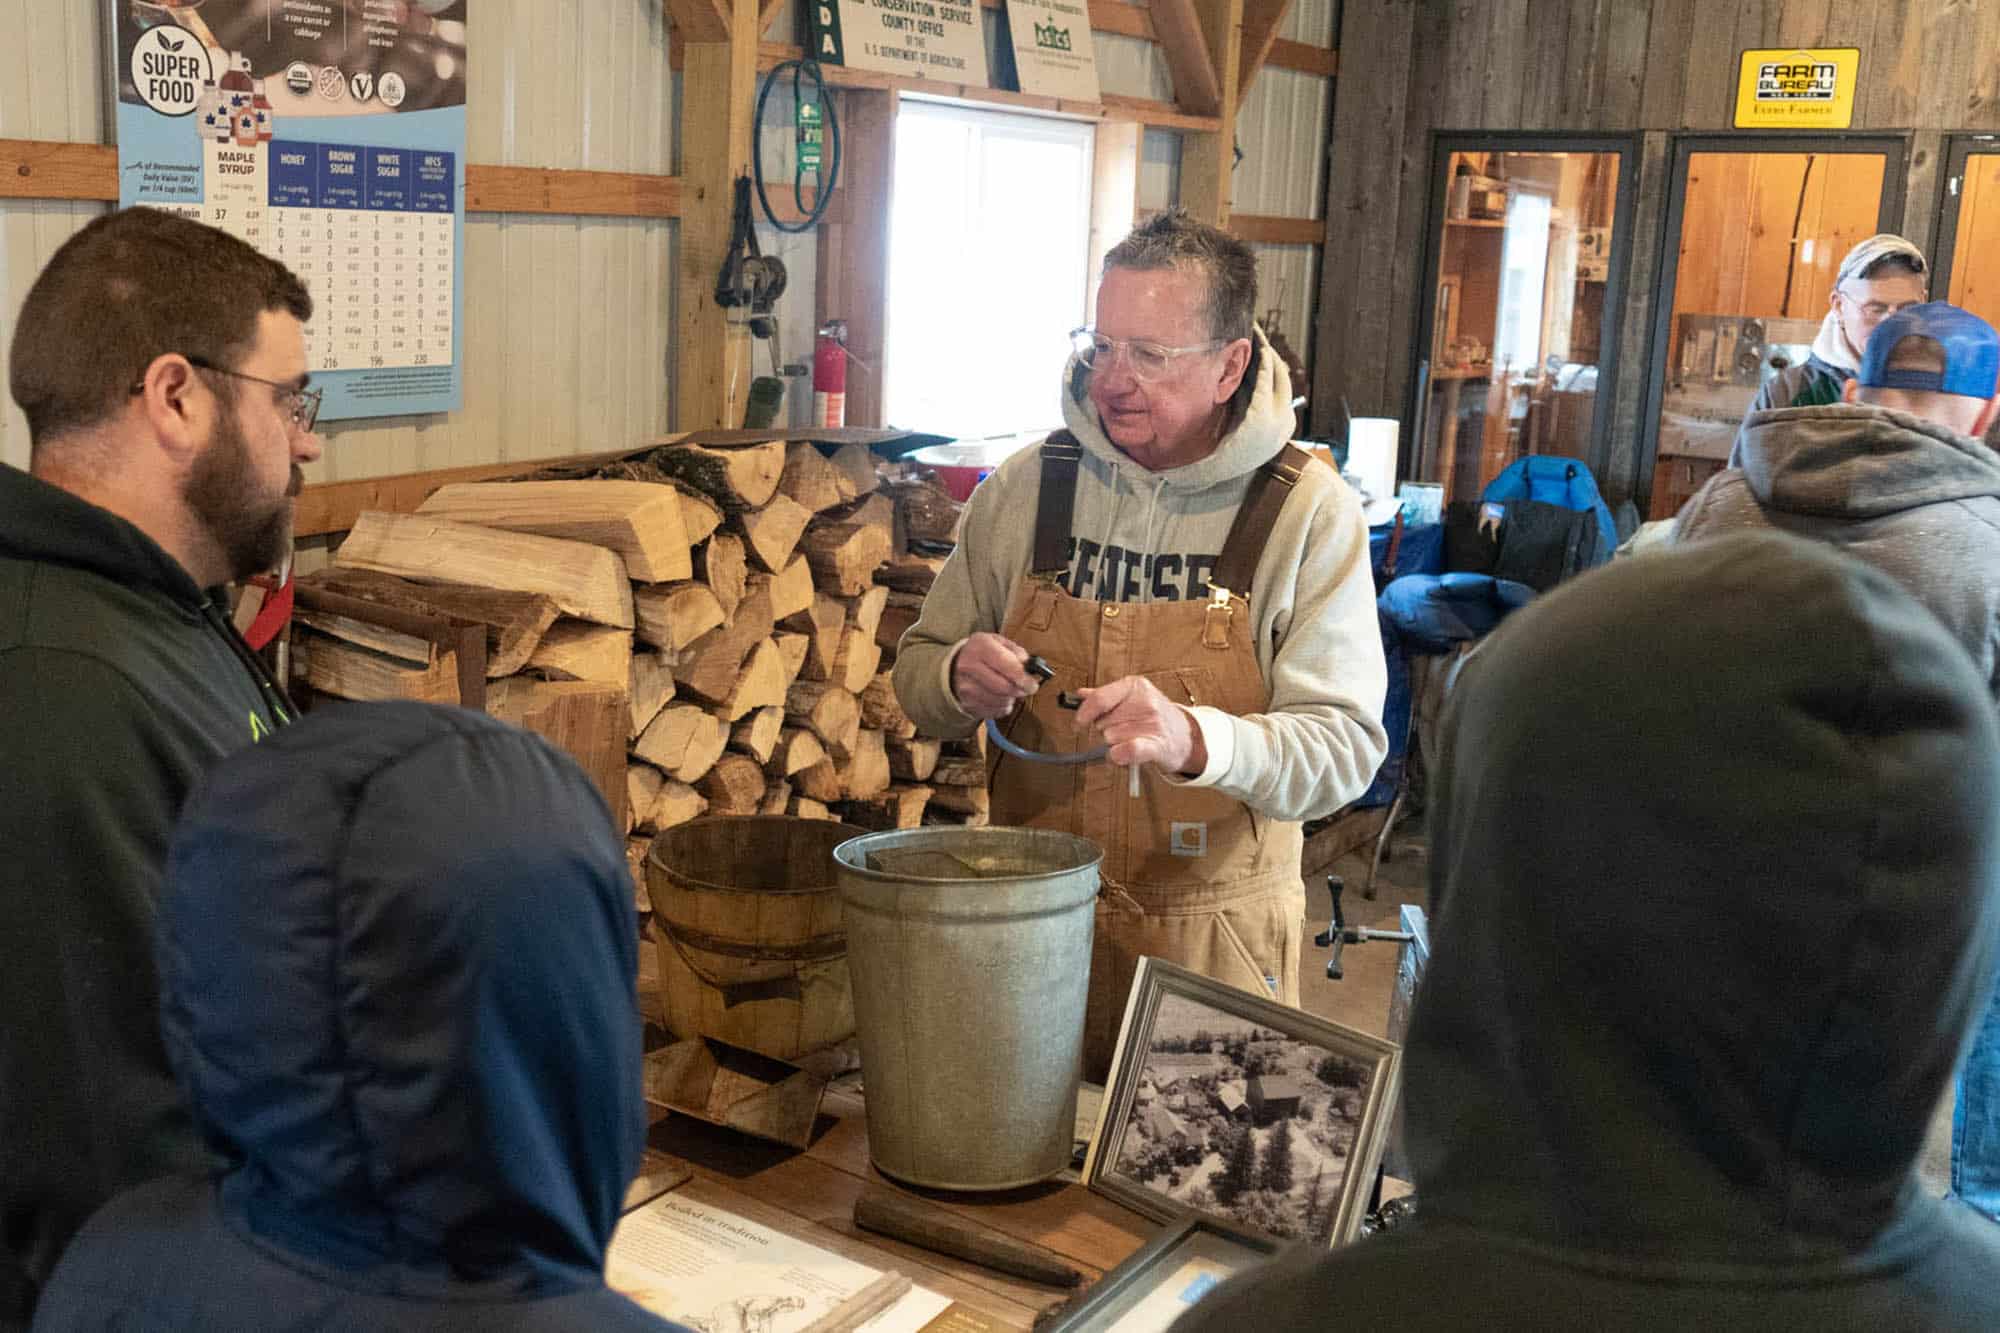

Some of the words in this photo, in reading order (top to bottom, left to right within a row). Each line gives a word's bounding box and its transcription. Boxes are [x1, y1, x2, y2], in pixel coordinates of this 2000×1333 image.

[940, 6, 972, 25] SERVICE
[882, 13, 915, 31] COUNTY
[918, 20, 944, 37] OFFICE
[143, 52, 200, 80] SUPER
[1760, 64, 1835, 78] FARM
[150, 78, 194, 103] FOOD
[1759, 79, 1833, 90] BUREAU
[218, 152, 255, 163] MAPLE
[281, 153, 306, 166] HONEY
[377, 154, 400, 165] WHITE
[219, 164, 255, 175] SYRUP
[330, 164, 354, 174] SUGAR
[377, 167, 400, 177] SUGAR
[215, 209, 226, 220] 37
[323, 357, 338, 369] 216
[371, 355, 383, 368] 196
